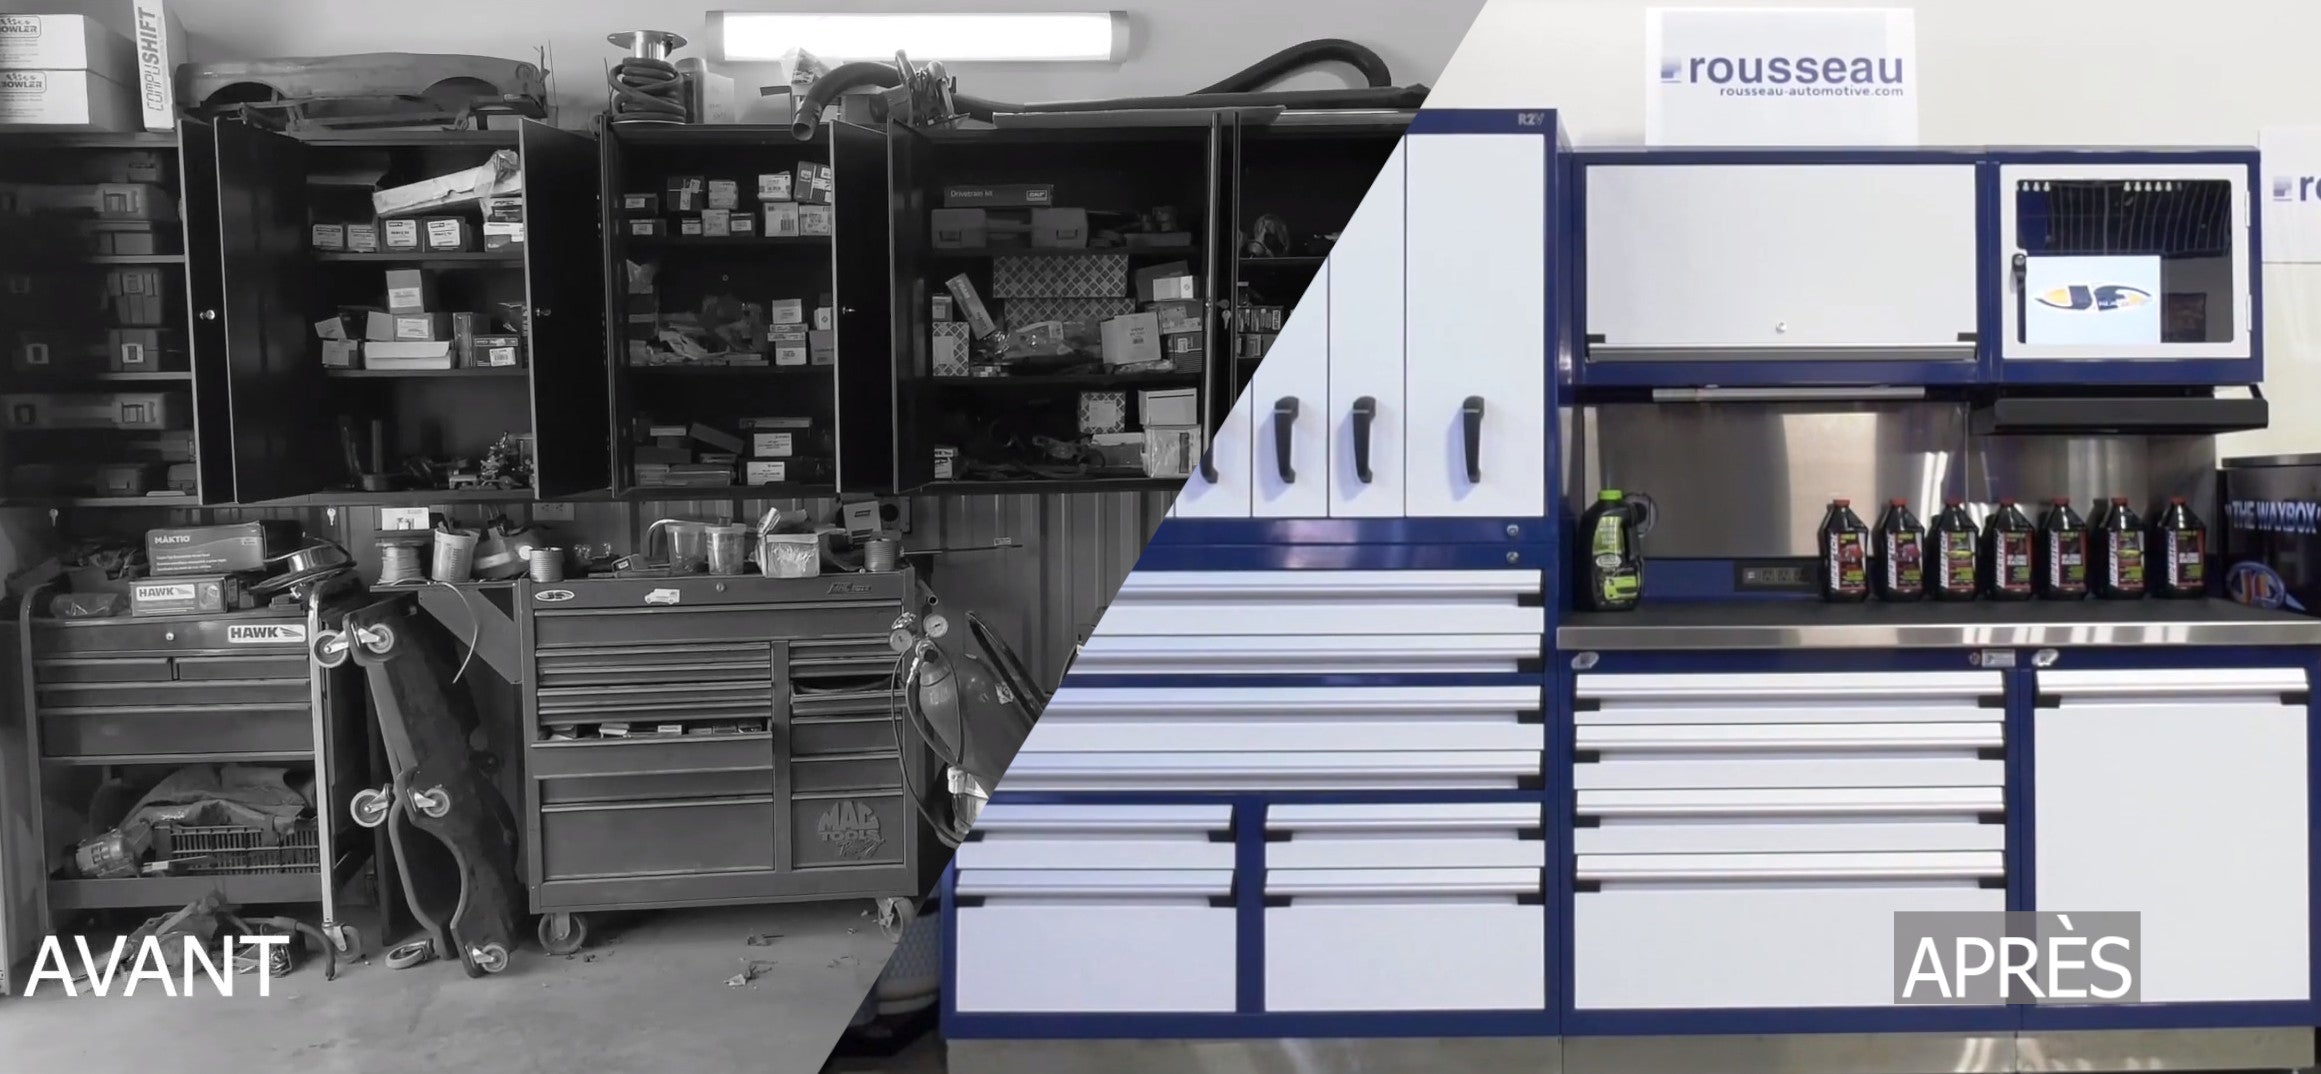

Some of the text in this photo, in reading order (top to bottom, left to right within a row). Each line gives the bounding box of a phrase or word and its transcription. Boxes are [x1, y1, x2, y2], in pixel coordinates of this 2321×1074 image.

[1689, 57, 1903, 84] rousseau
[1720, 86, 1904, 97] rousseau-automotive.com
[138, 586, 174, 598] HAWK
[230, 626, 278, 639] HAWK
[818, 800, 880, 831] MAC
[819, 829, 880, 841] TOOLS
